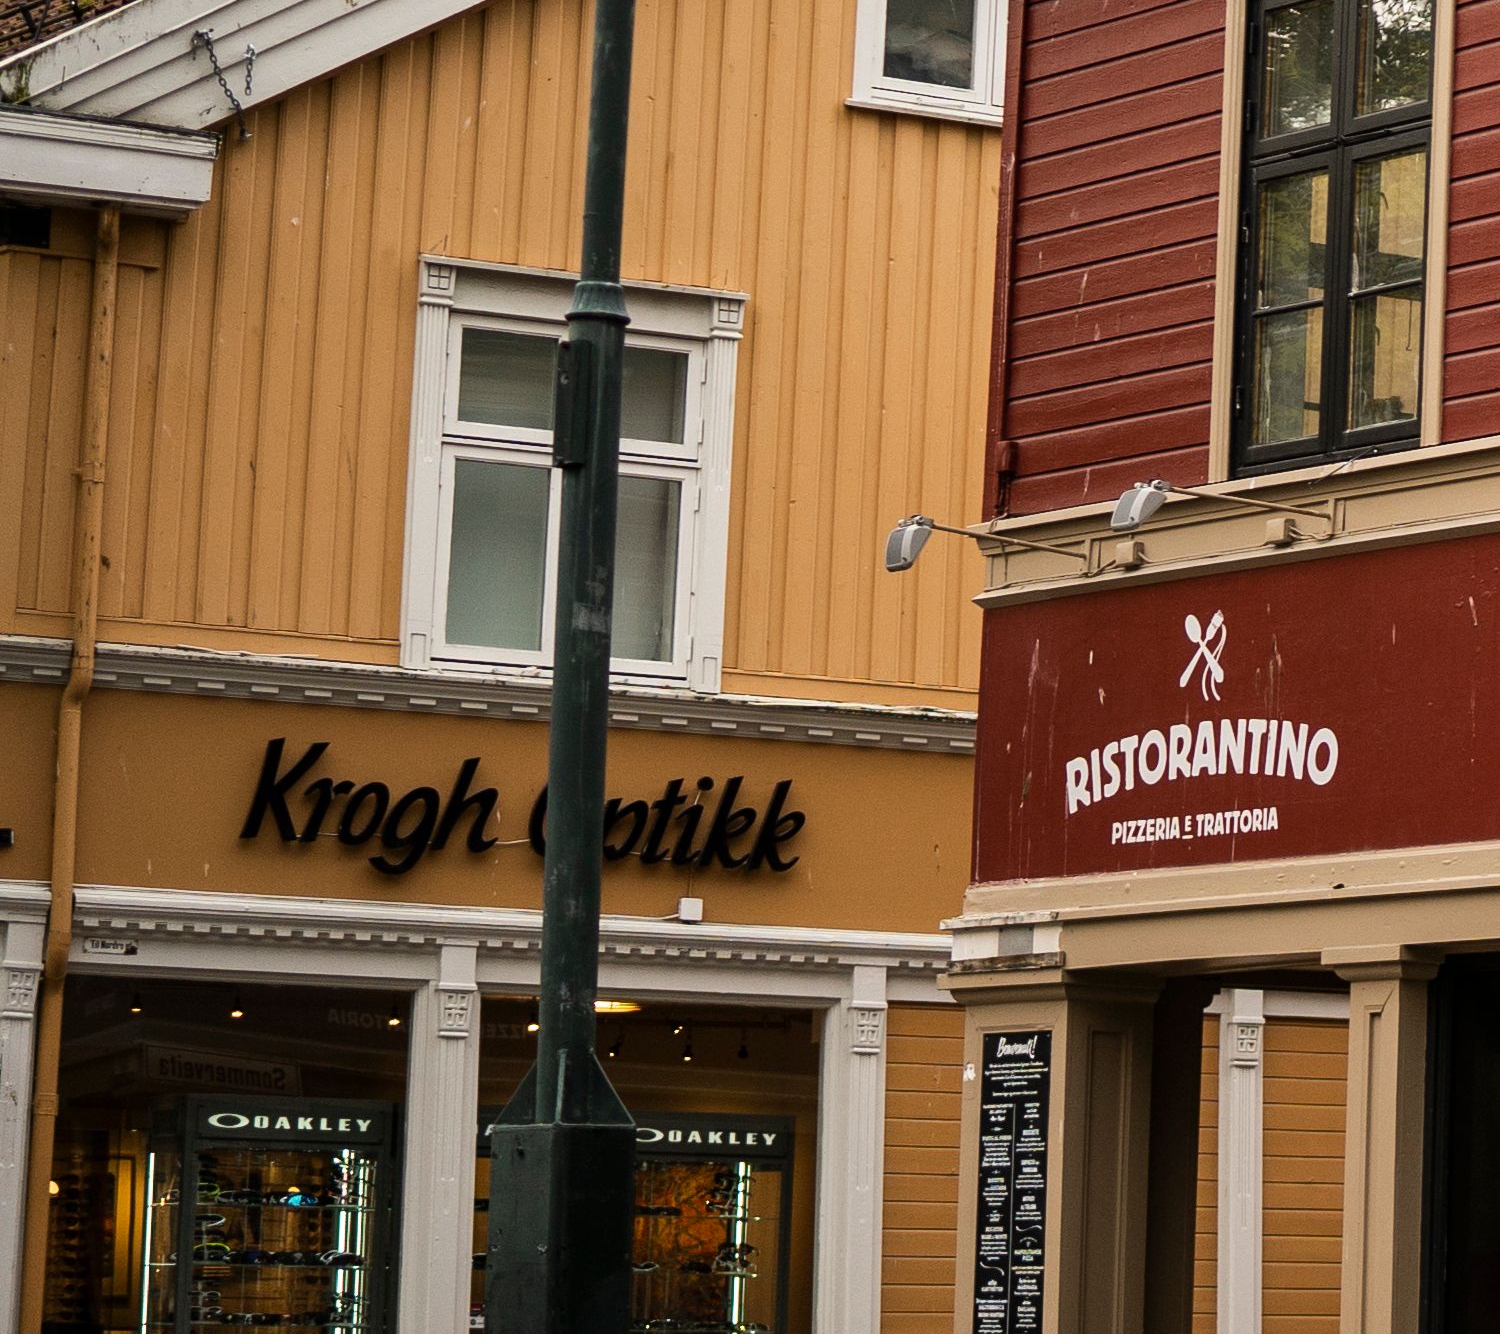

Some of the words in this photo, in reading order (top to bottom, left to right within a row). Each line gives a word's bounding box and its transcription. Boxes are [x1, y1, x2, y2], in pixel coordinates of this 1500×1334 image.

[1065, 718, 1339, 815] RISTORANTINO
[239, 737, 499, 875] Krogh
[529, 775, 806, 870] ptikk
[1111, 817, 1181, 845] PIZZERIA
[1196, 806, 1279, 837] TRATTORIA
[253, 1115, 372, 1132] OAKLEY
[668, 1129, 777, 1146] OAKLEY
